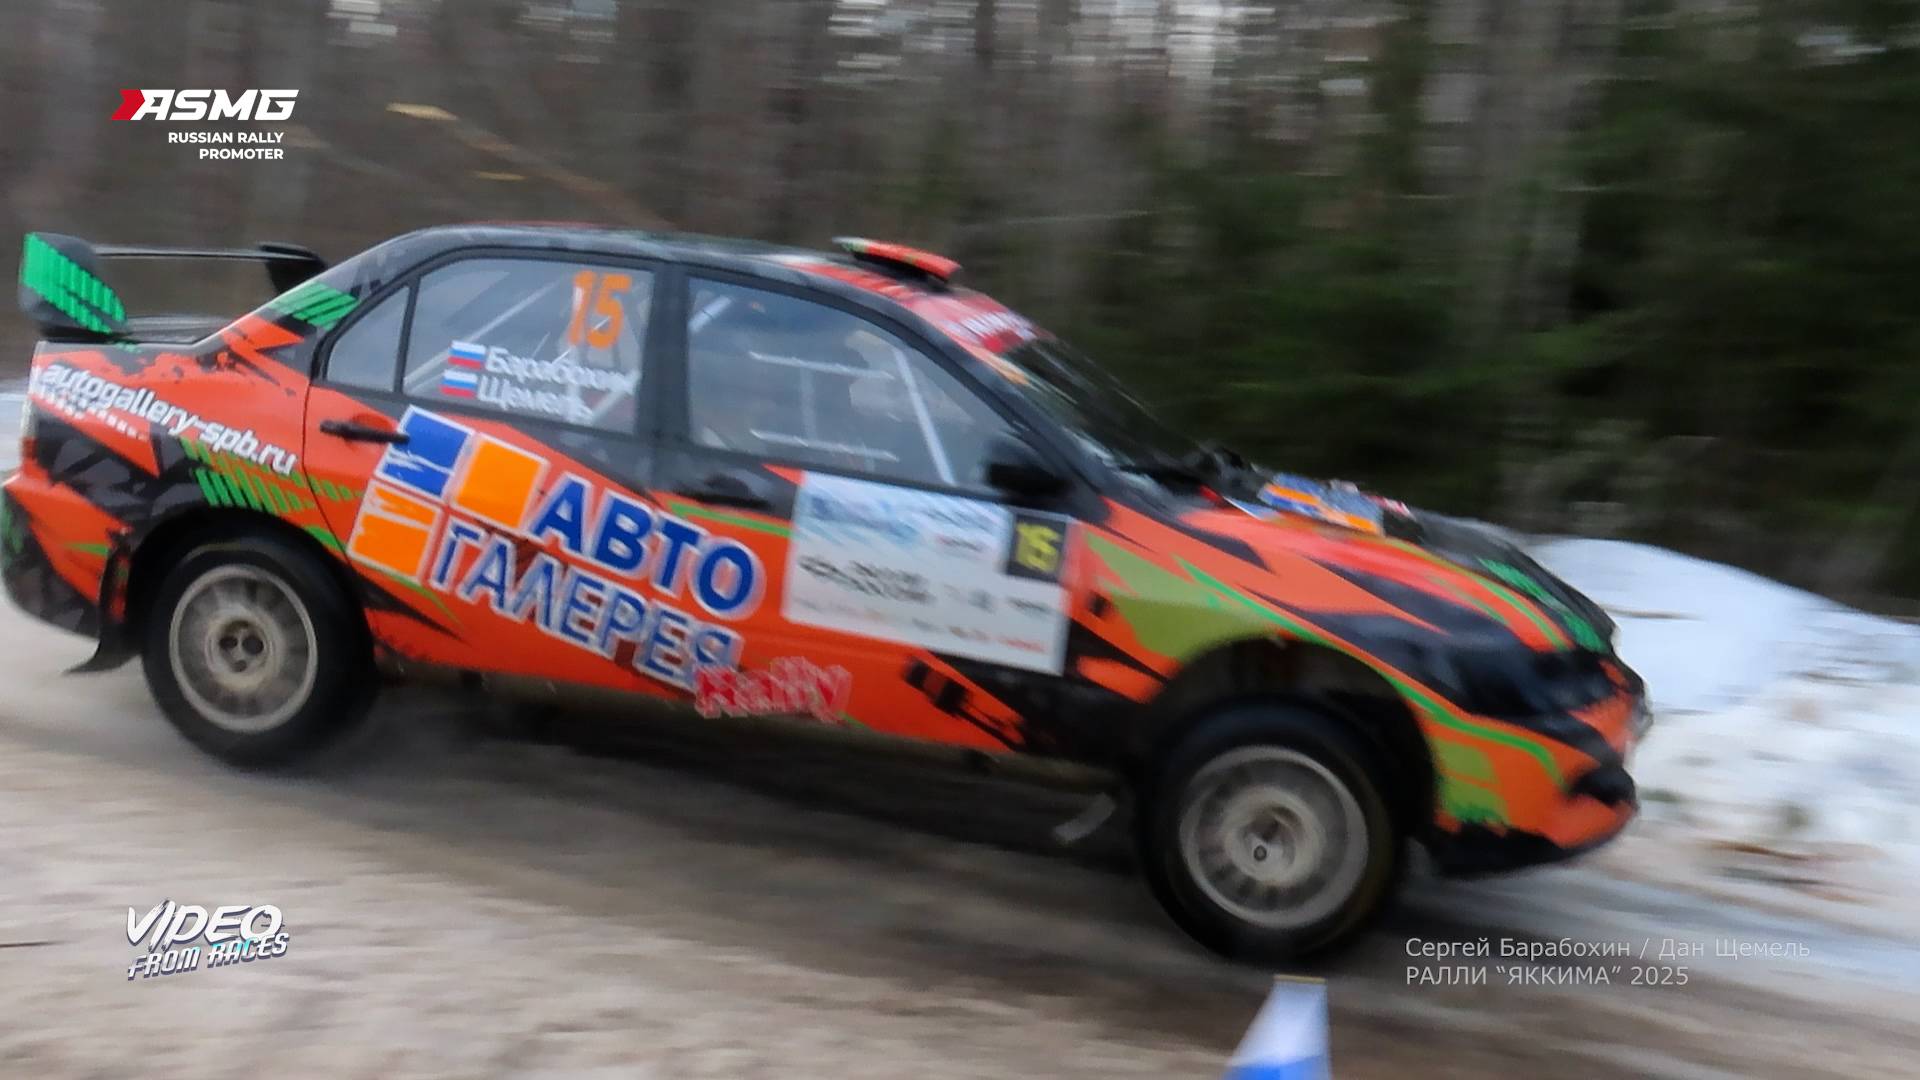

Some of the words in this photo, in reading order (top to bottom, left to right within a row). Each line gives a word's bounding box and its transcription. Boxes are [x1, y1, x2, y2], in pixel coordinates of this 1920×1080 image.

[568, 270, 632, 350] 15
[39, 364, 297, 475] autogallery-spb.ru
[431, 512, 743, 695] ГАЛЕРЕЯ
[529, 473, 764, 620] АВТО
